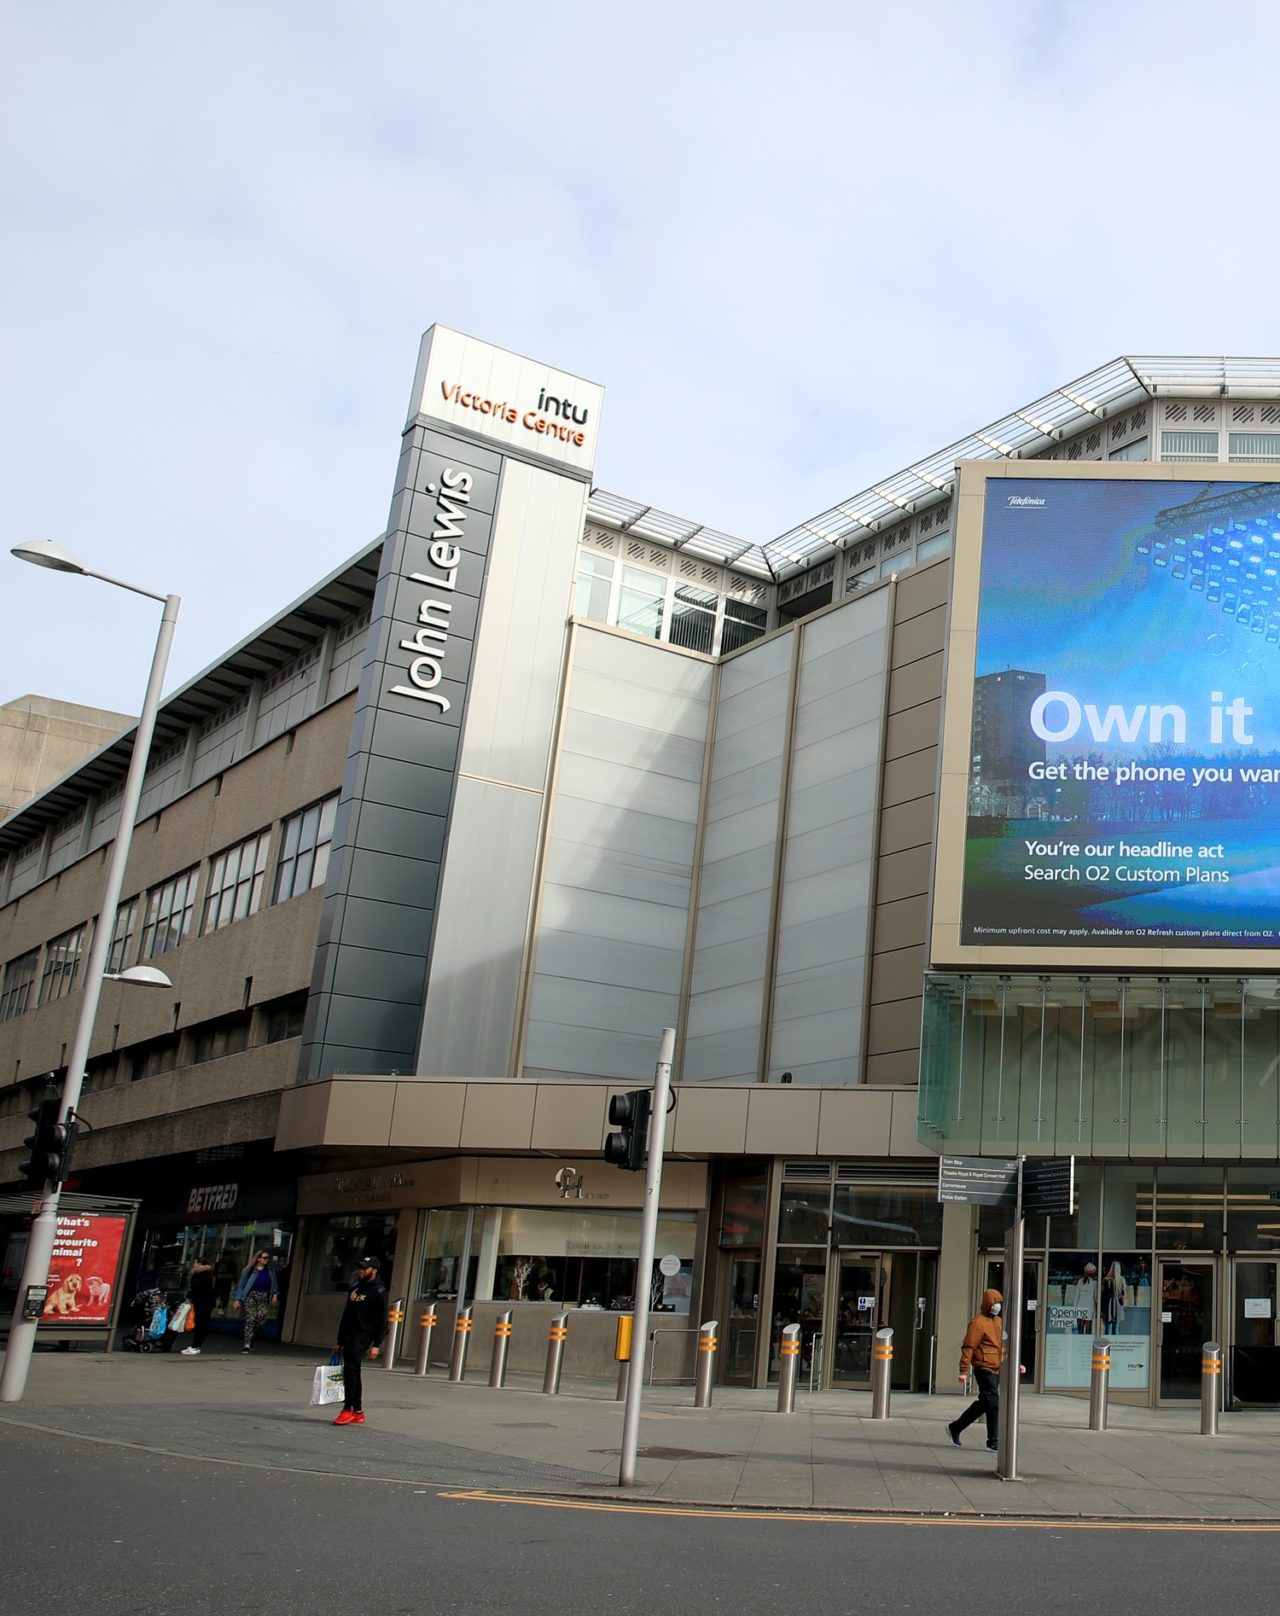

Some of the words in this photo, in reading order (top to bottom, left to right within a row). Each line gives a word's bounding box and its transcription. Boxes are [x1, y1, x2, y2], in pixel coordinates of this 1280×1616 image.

[441, 380, 517, 424] Victoria
[523, 411, 586, 447] Centre
[537, 387, 589, 425] intu
[407, 467, 473, 591] Lewis
[387, 598, 453, 714] John
[1030, 690, 1187, 744] Own
[1210, 691, 1254, 745] it
[1028, 761, 1067, 781] Get
[1073, 761, 1110, 782] the
[1115, 762, 1186, 786] phone
[1191, 766, 1232, 787] you
[1024, 840, 1080, 857] You're
[1084, 844, 1115, 858] our
[1119, 841, 1193, 859] headline
[1198, 843, 1224, 859] act
[1024, 864, 1080, 881] Search
[1085, 866, 1110, 882] O2
[1115, 867, 1181, 883] Custom
[1186, 867, 1229, 883] Plans
[1008, 927, 1035, 936] upfront
[1068, 928, 1090, 936] apply.
[1091, 928, 1124, 936] Available
[1201, 929, 1221, 937] plans
[1222, 929, 1242, 937] direct
[187, 1183, 239, 1213] BETFRED
[52, 1248, 83, 1257] nimal
[53, 1239, 98, 1247] avourite
[1050, 1319, 1075, 1328] times
[1051, 1307, 1088, 1318] Opening
